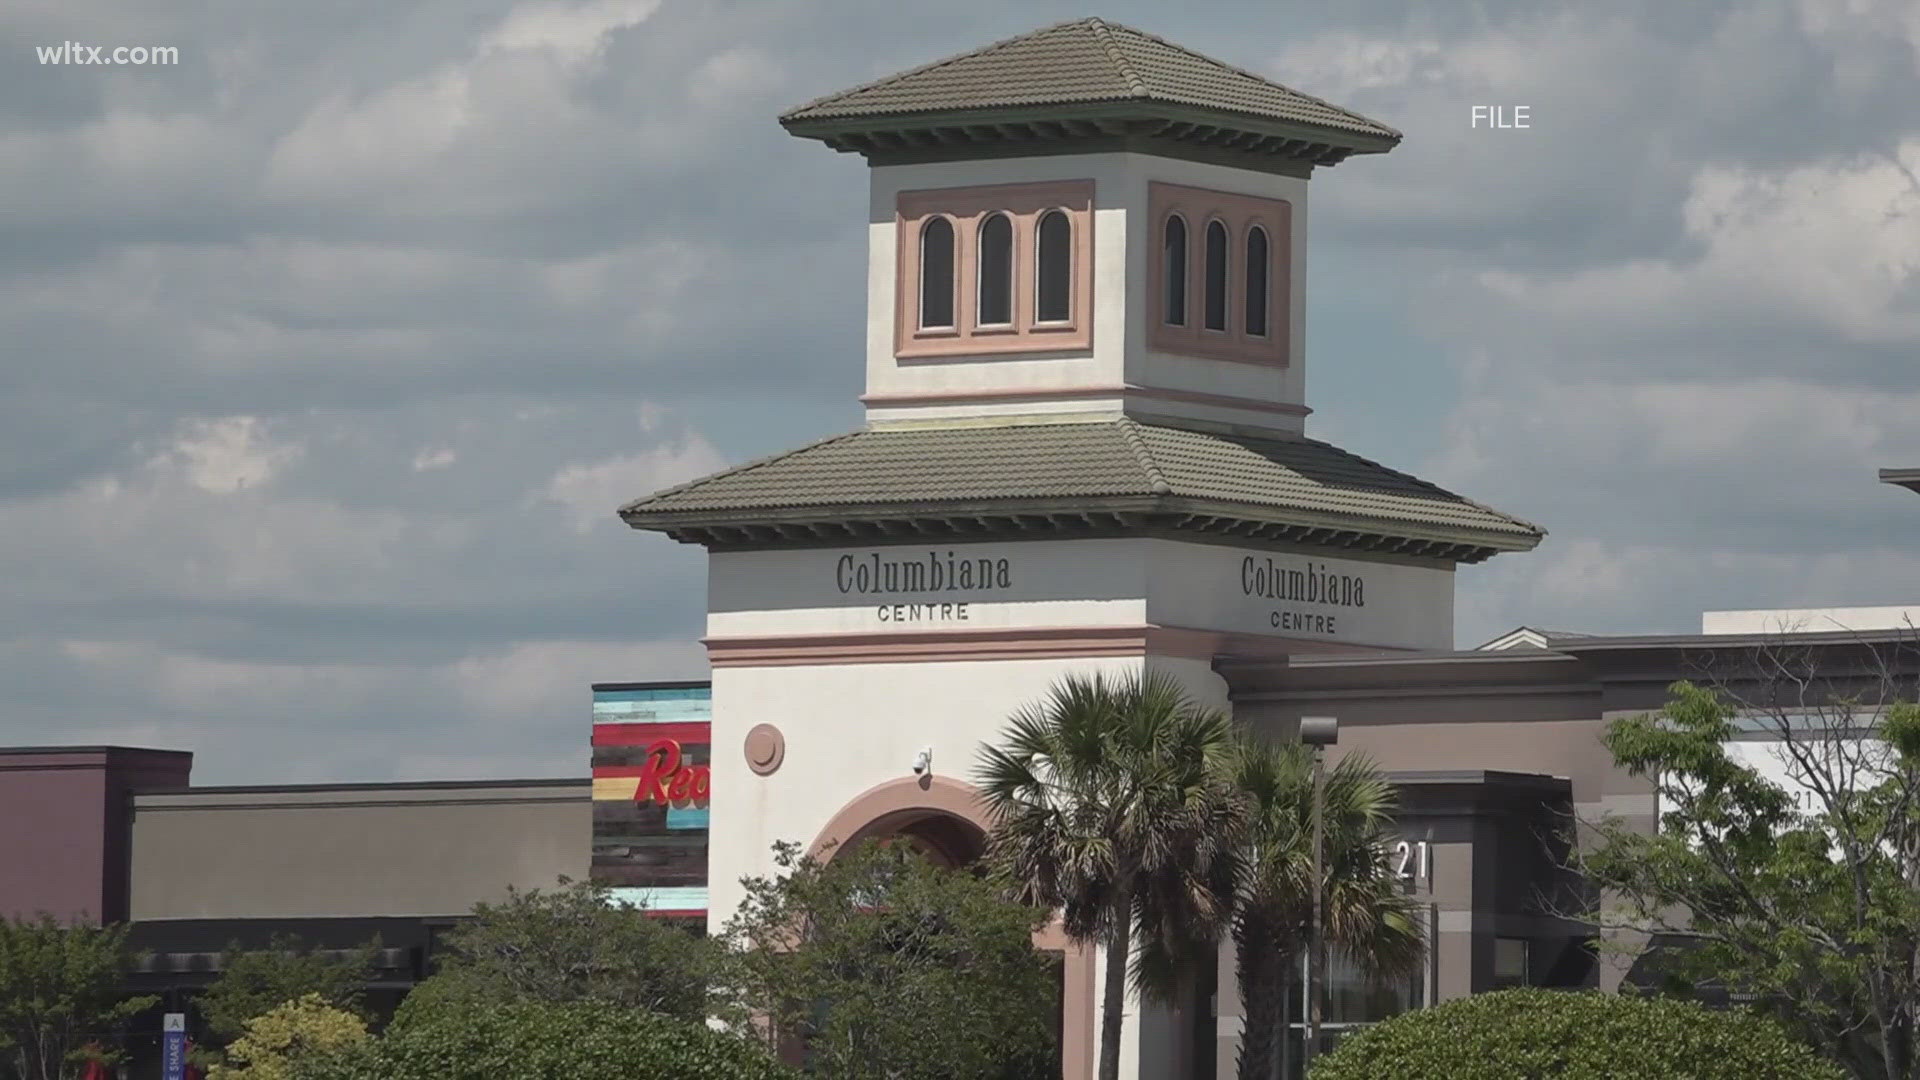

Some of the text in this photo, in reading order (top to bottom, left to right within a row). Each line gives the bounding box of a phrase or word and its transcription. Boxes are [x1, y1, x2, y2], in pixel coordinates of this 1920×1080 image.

[836, 550, 1012, 594] Columbiana
[1241, 555, 1365, 608] Columbiana
[877, 602, 969, 622] CENTRE
[1270, 610, 1336, 635] CENTRE
[1396, 840, 1427, 879] 21
[168, 1038, 181, 1072] SHARE
